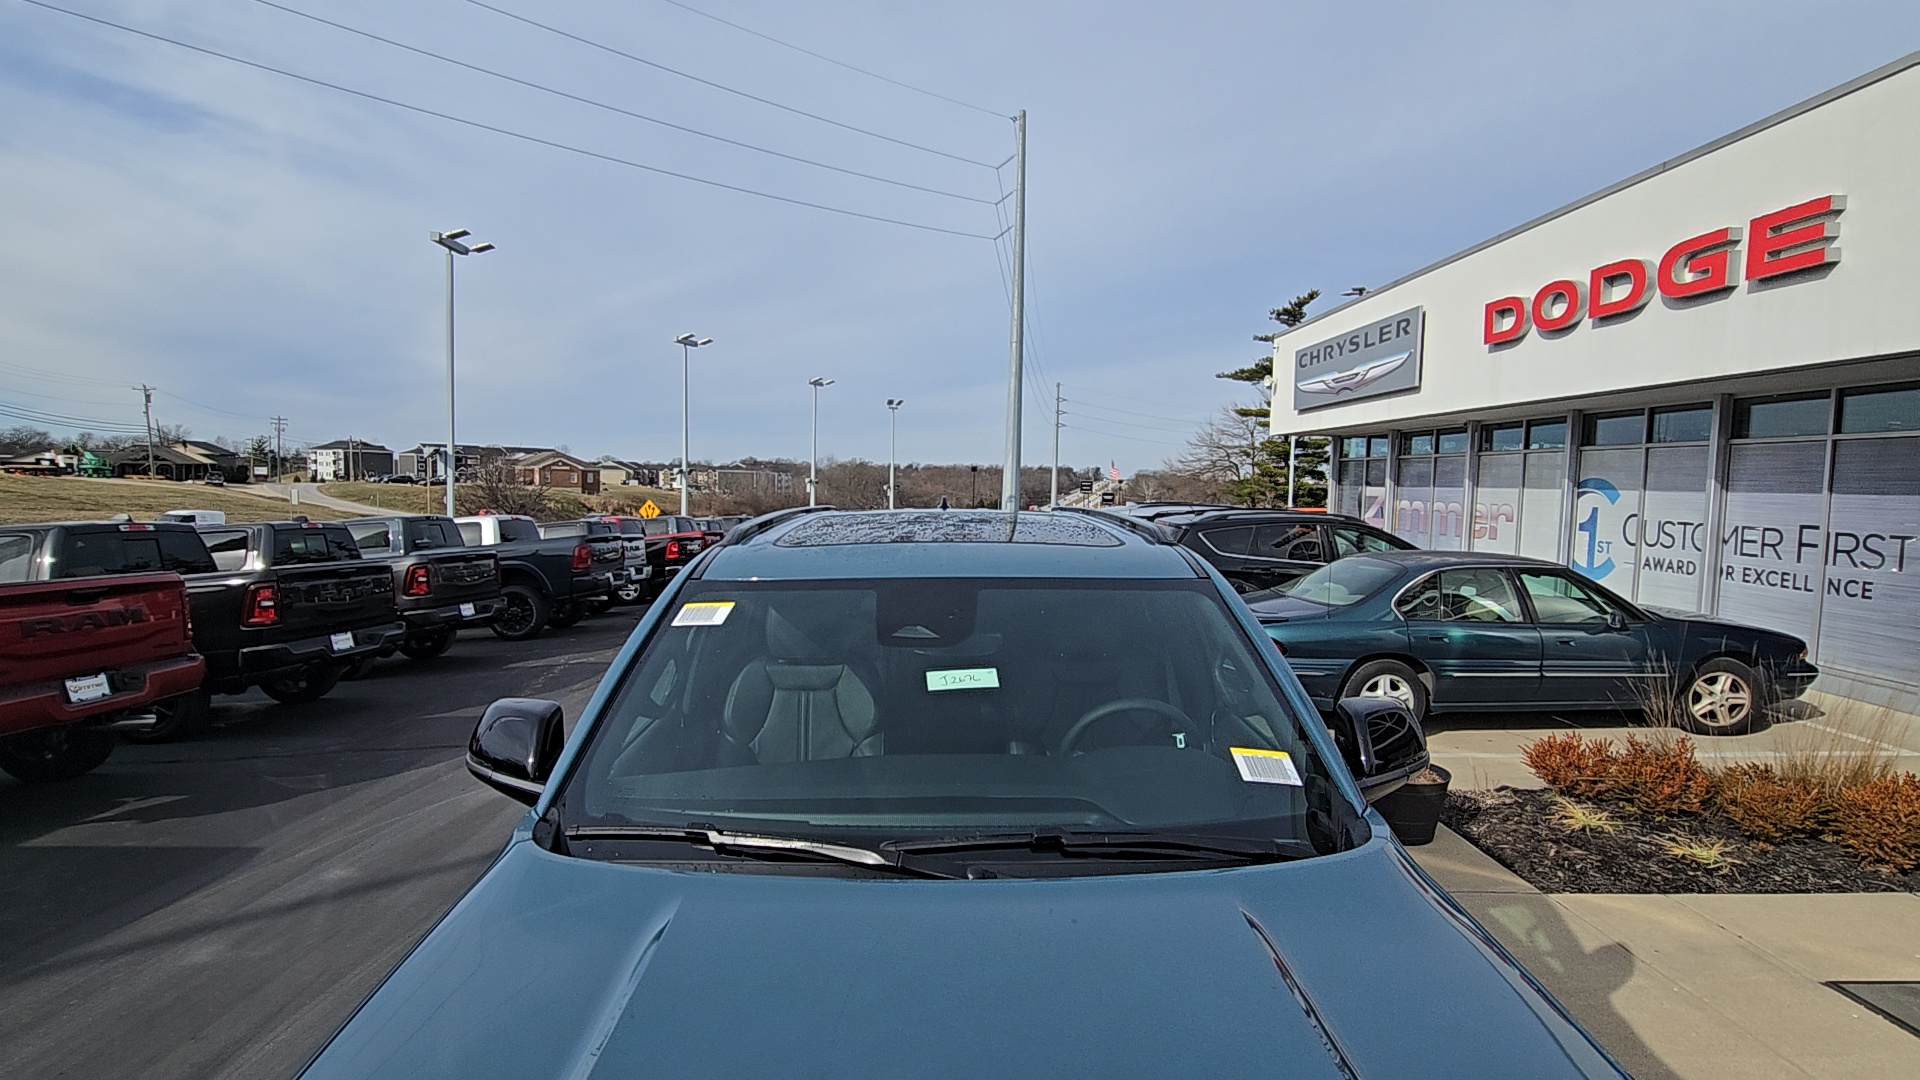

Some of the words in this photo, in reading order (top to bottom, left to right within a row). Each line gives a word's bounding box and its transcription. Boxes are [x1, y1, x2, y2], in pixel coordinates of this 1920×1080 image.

[1484, 195, 1846, 345] DODGE
[1298, 318, 1411, 368] CHRYSLER
[1363, 486, 1514, 541] Zmmer
[1641, 556, 1697, 576] AWARD
[1741, 566, 1874, 600] EXCELLNCE
[20, 608, 145, 638] RAM
